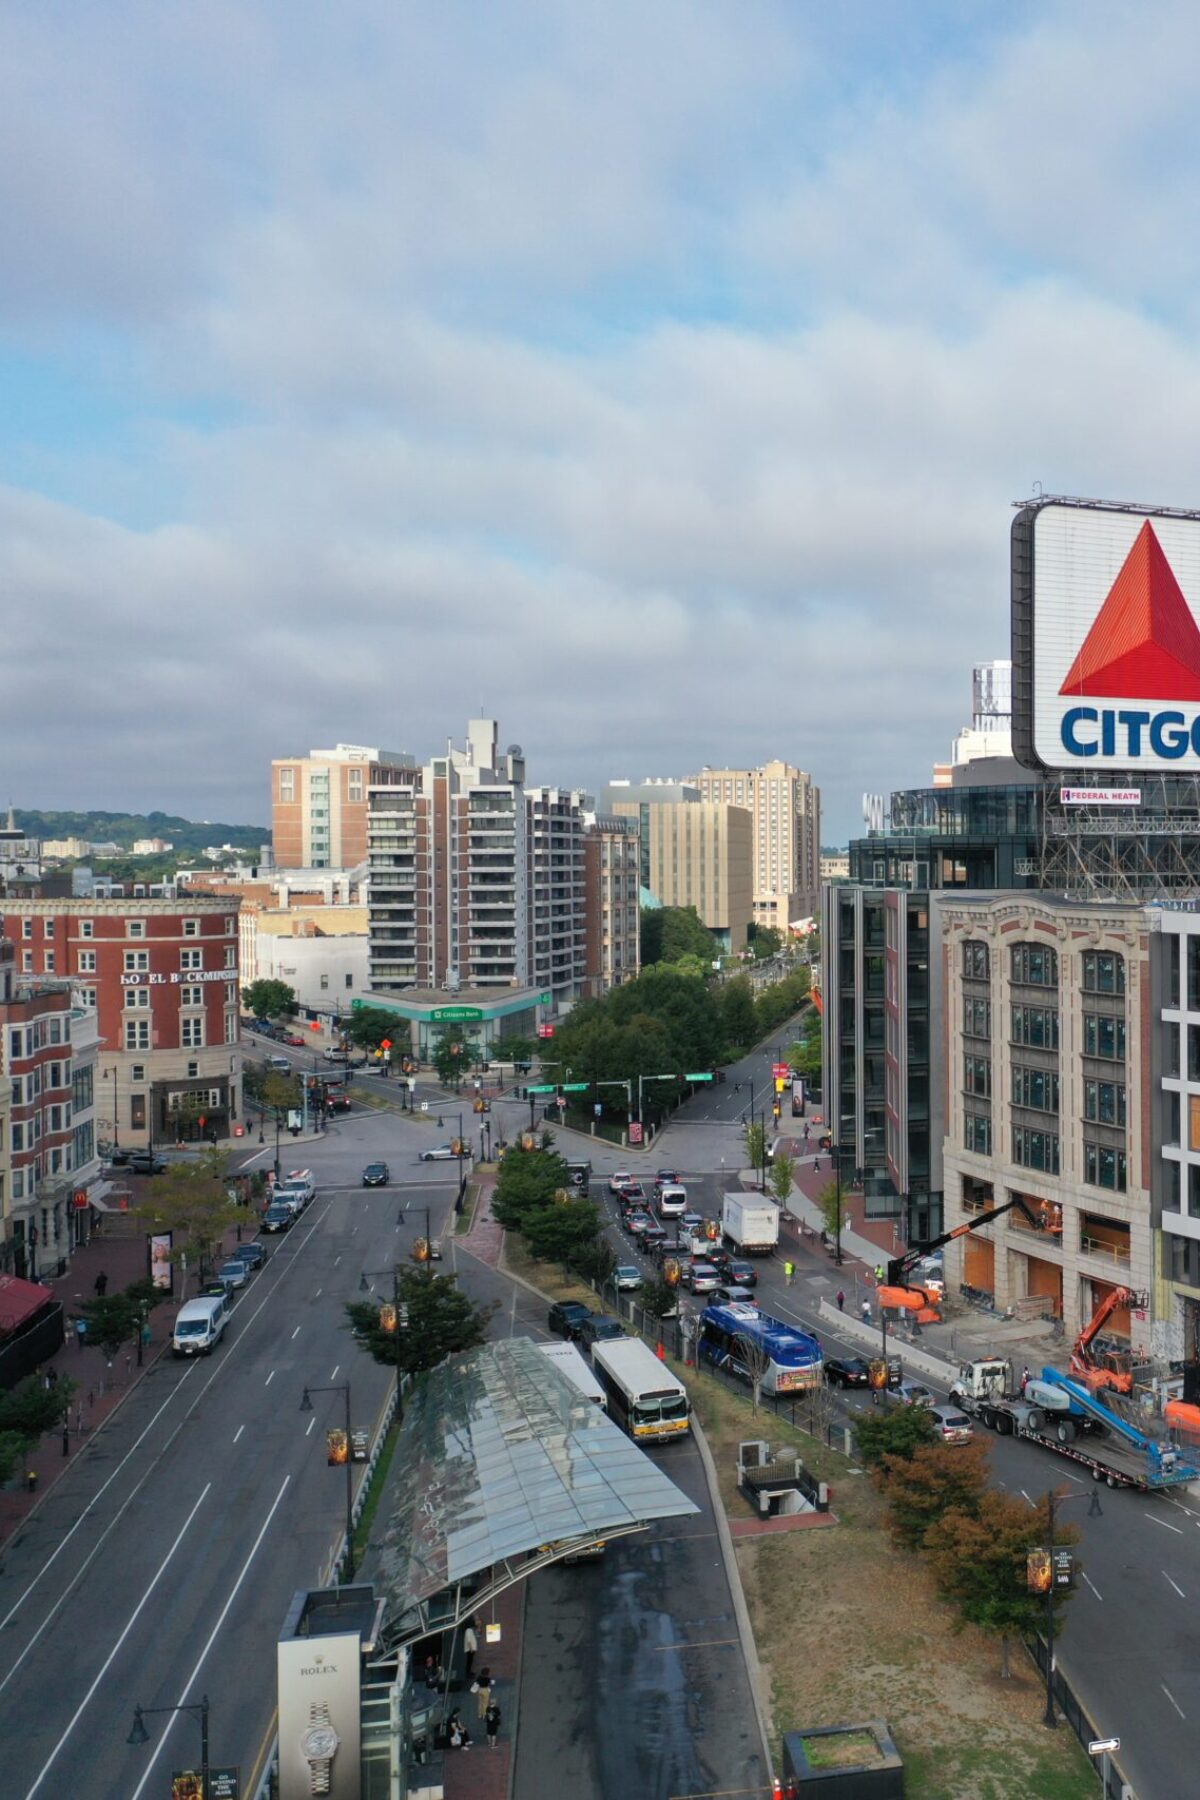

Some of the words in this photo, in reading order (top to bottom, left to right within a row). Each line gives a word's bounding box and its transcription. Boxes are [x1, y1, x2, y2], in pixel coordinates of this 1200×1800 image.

[1071, 792, 1109, 800] FEDERAL
[1111, 792, 1140, 800] HEATH
[120, 974, 166, 985] HOEL
[300, 1665, 338, 1676] ROLEX
